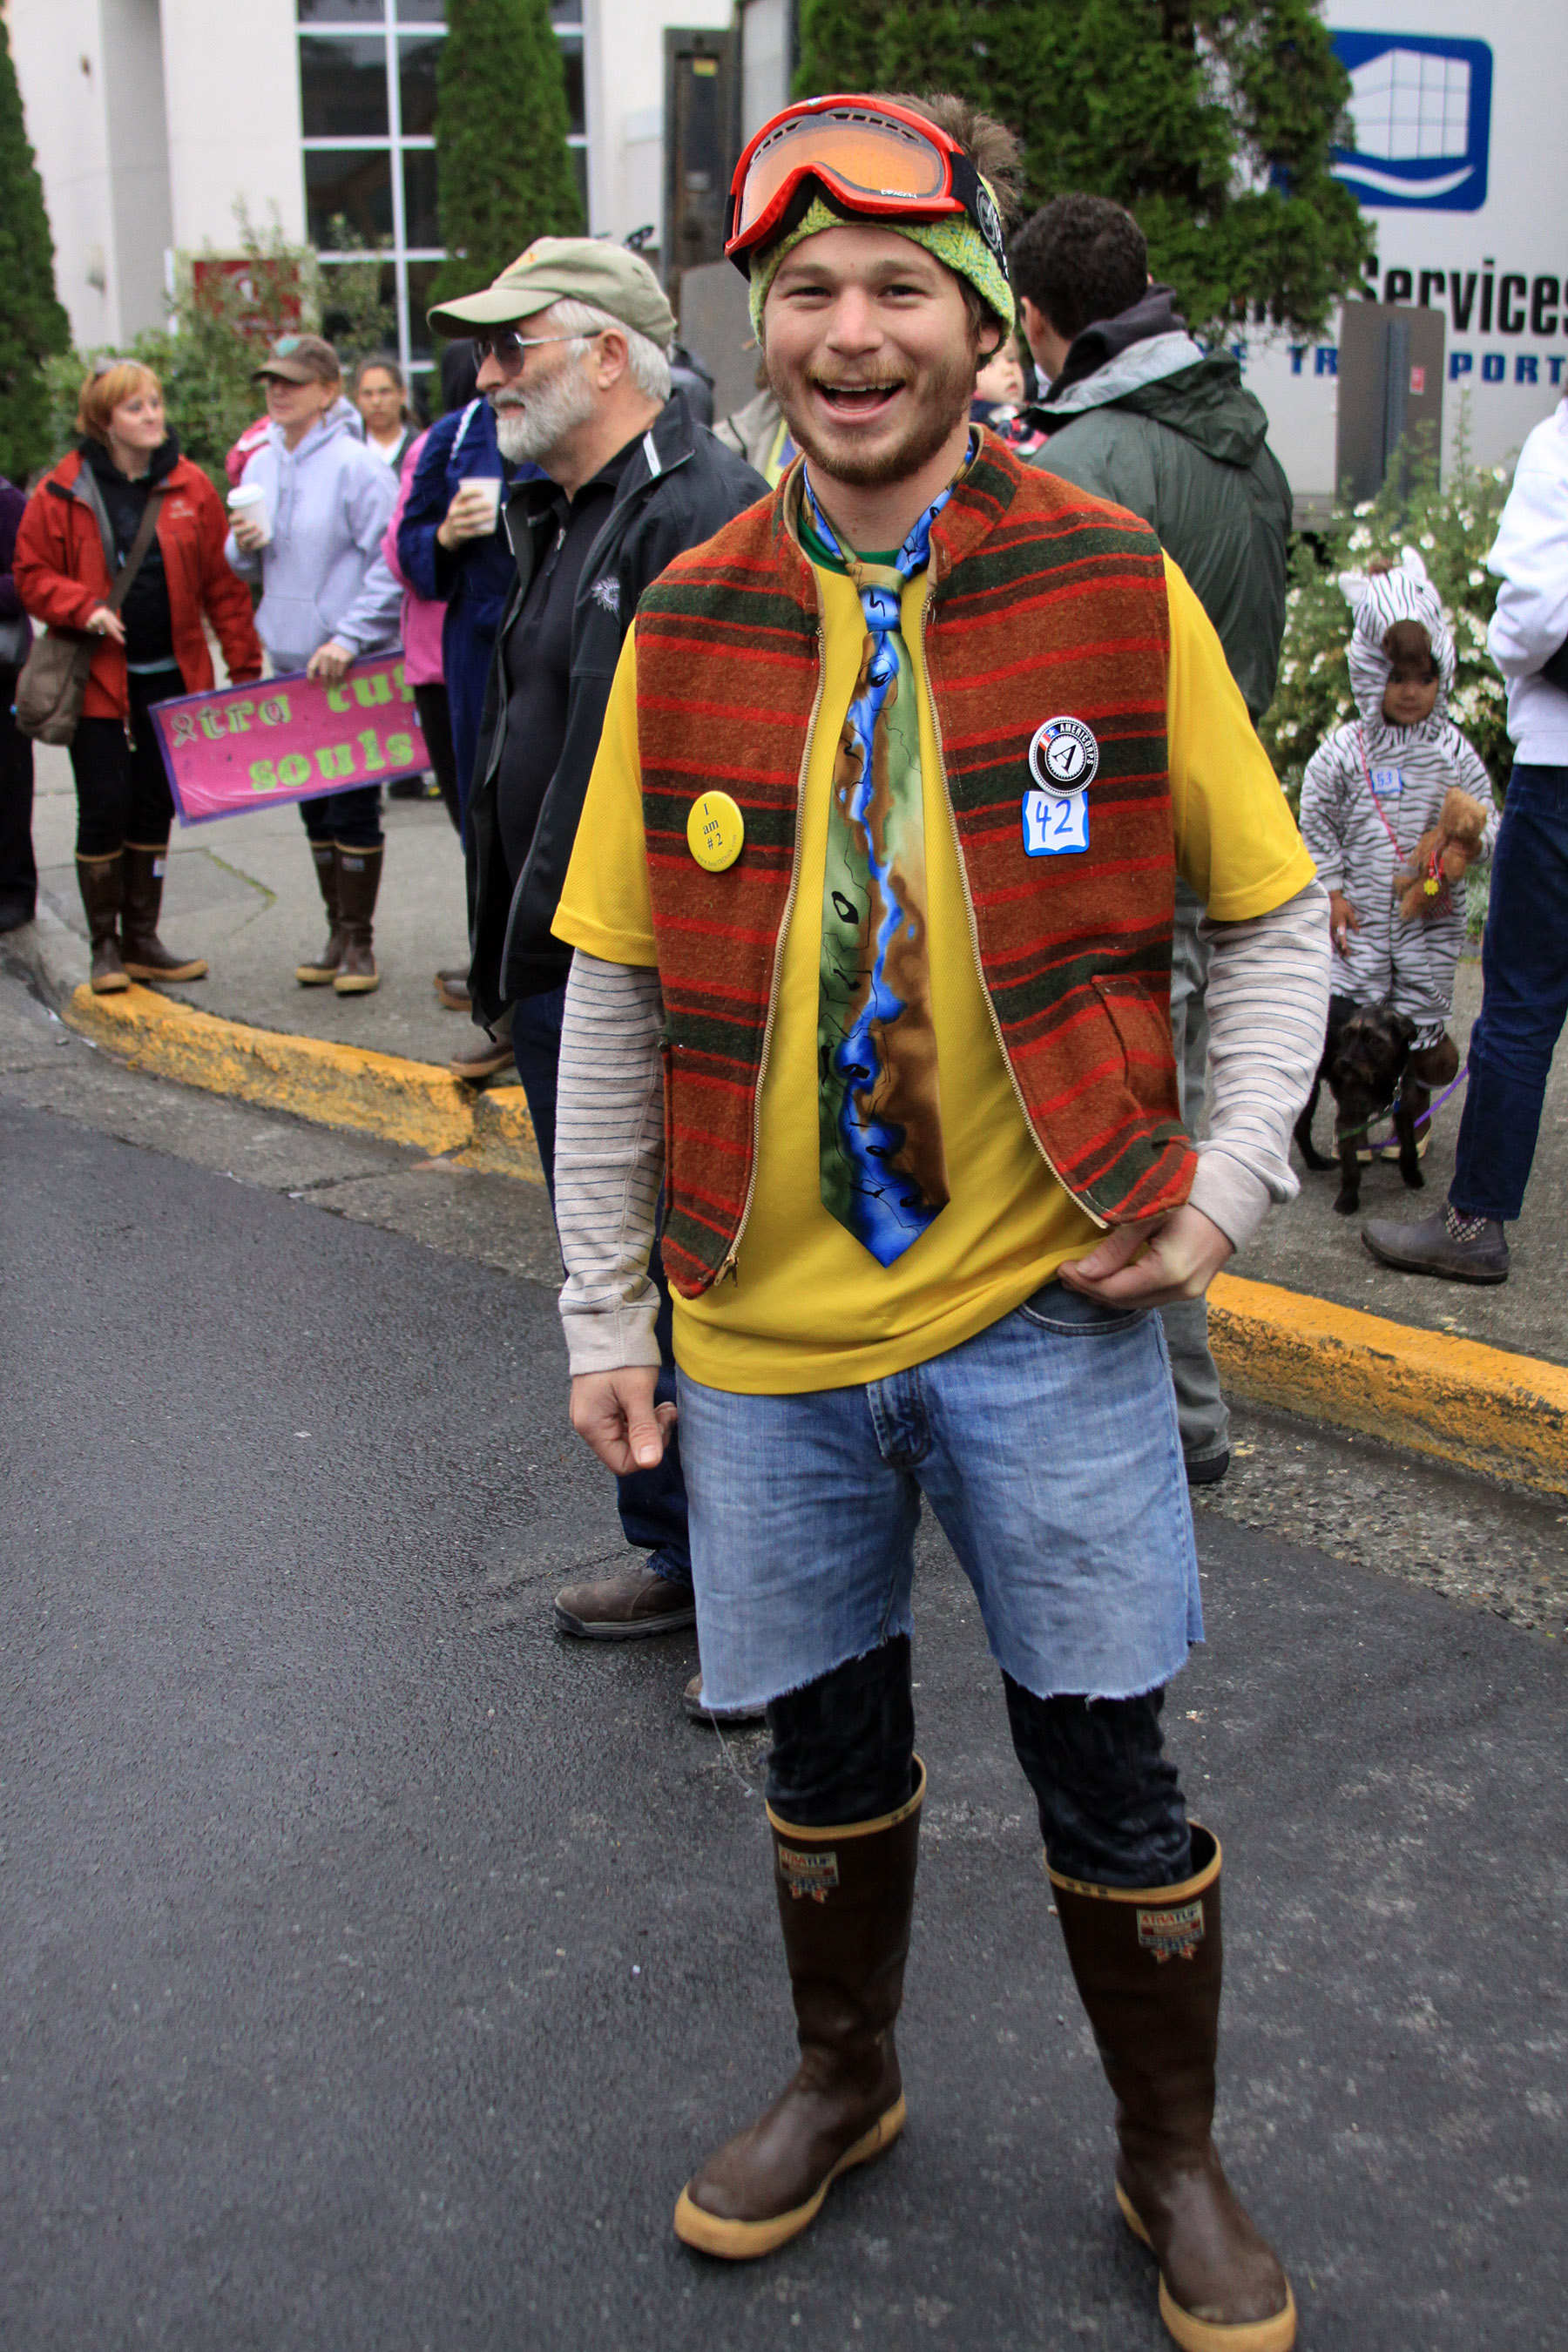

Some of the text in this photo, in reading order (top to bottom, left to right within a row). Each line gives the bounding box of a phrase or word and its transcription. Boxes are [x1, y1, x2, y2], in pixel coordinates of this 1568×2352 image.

[1364, 254, 1568, 336] ervice
[249, 729, 415, 792] souls
[1059, 723, 1094, 765] AMERICORPS
[1376, 771, 1392, 787] 53
[702, 820, 719, 835] am
[1036, 800, 1073, 842] 42
